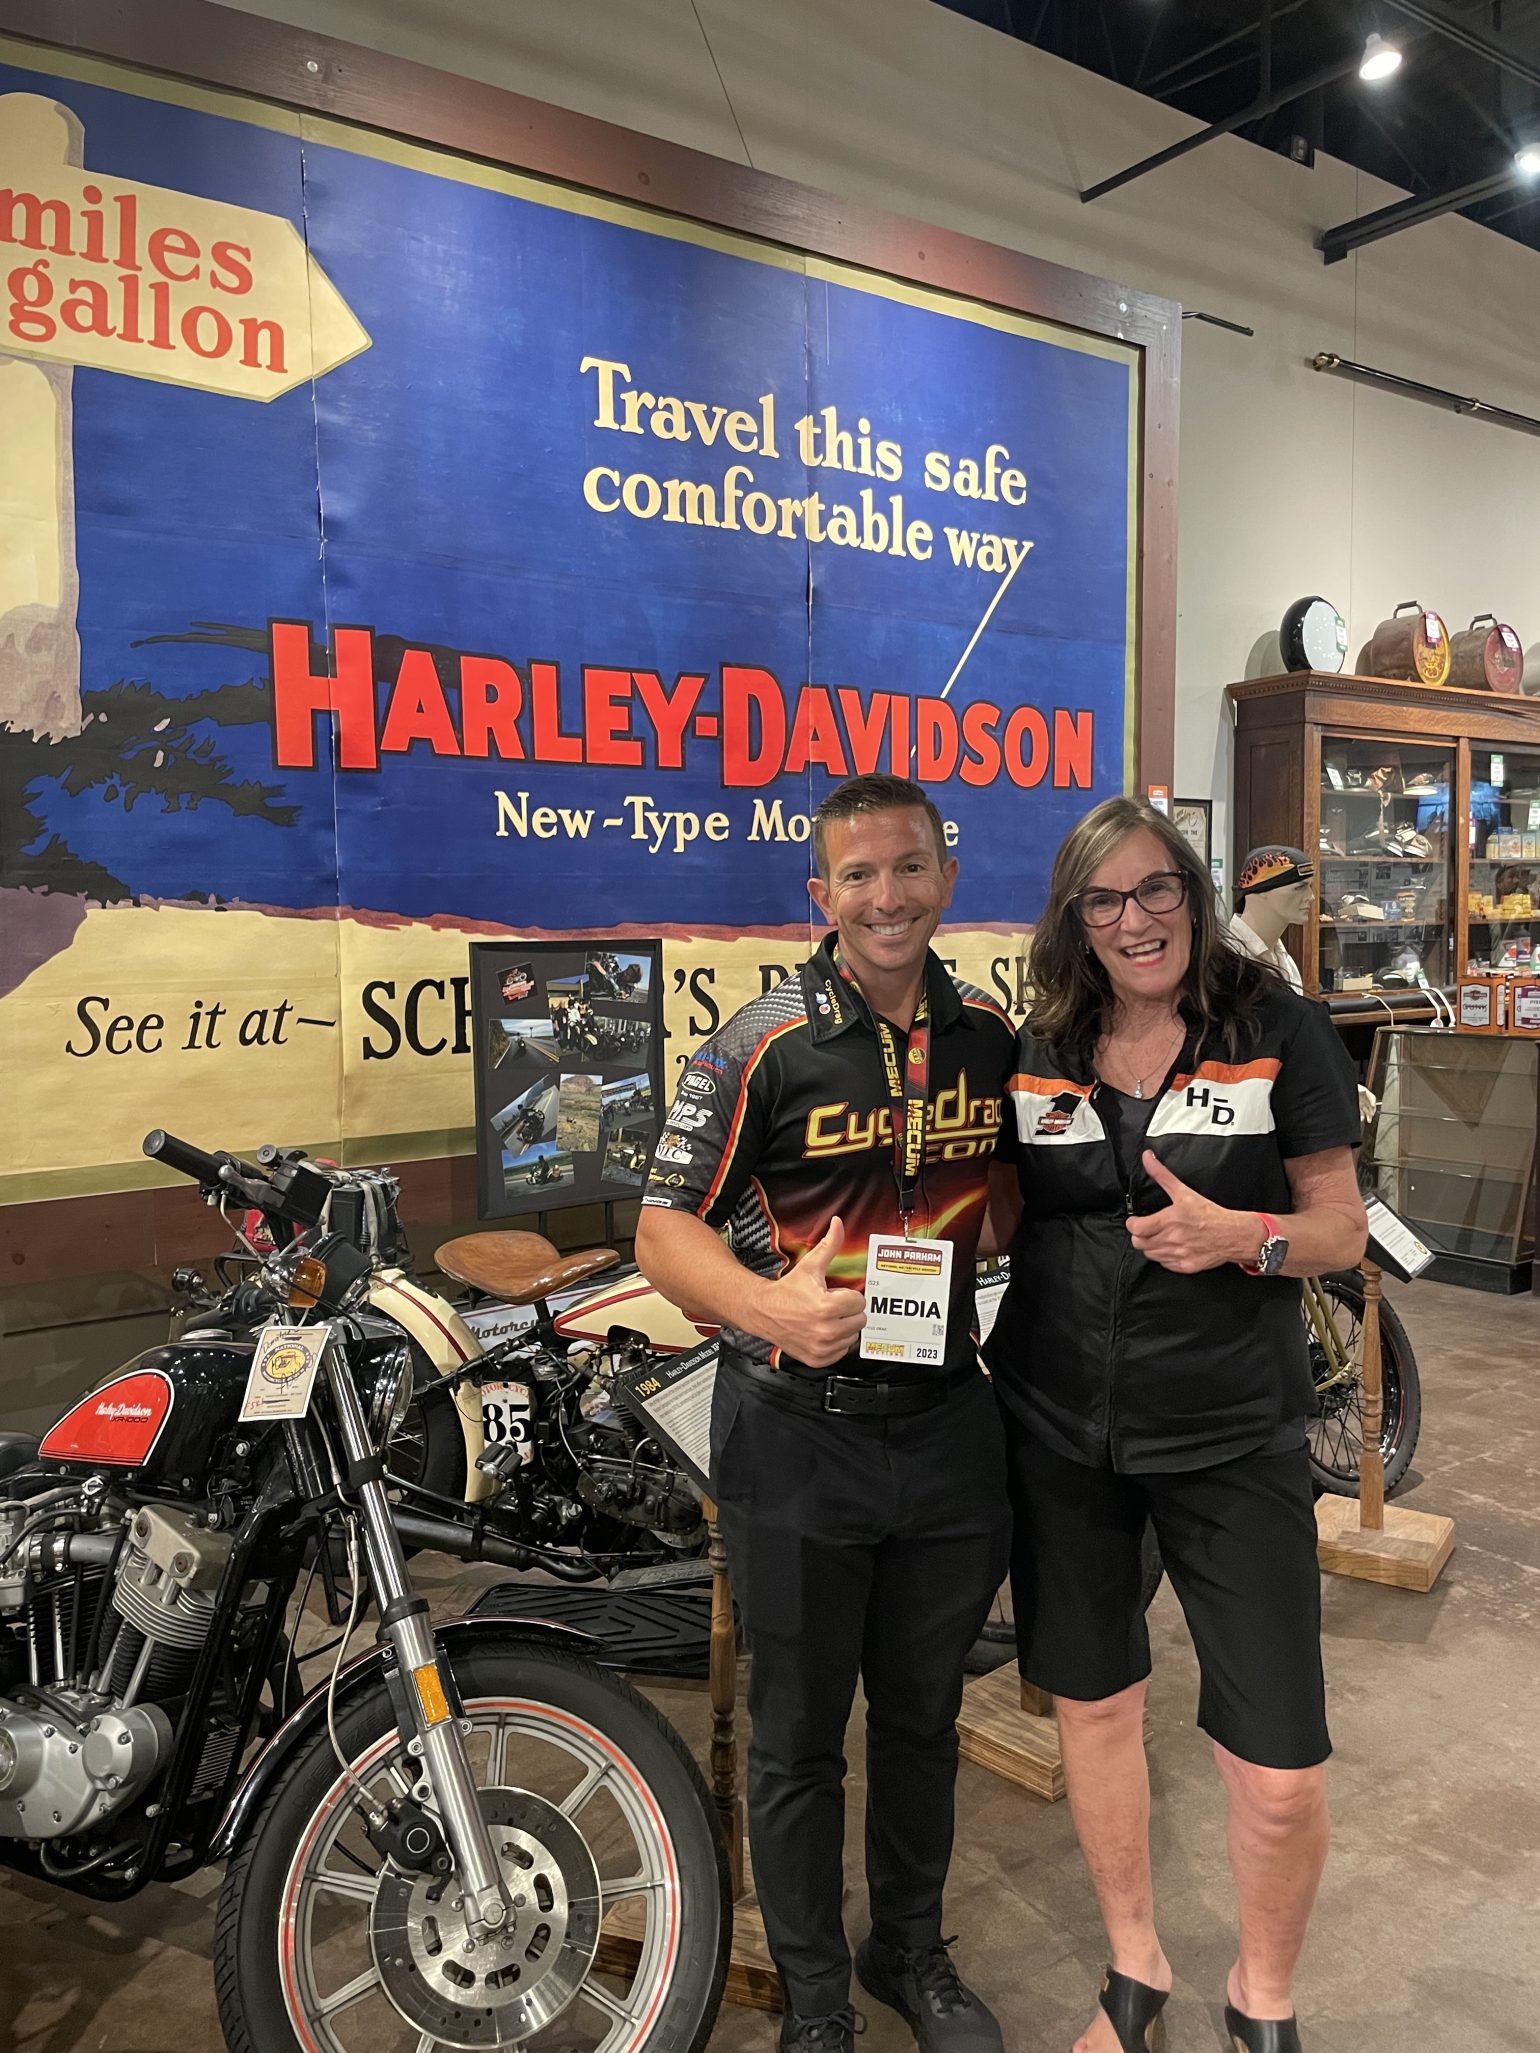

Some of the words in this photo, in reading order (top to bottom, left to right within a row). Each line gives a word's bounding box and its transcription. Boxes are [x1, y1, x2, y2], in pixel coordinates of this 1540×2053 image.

[0, 185, 254, 296] miles
[7, 258, 289, 375] gallon
[579, 356, 780, 459] Travel
[794, 405, 903, 483] this
[923, 444, 1028, 506] safe
[582, 465, 934, 561] comfortable
[270, 621, 1095, 788] HARLEY-DAVIDSON
[65, 996, 165, 1058] See
[181, 999, 227, 1051] it
[824, 979, 843, 1025] CycleDrag
[879, 1022, 903, 1097] MECUM
[905, 1099, 925, 1177] MECUM
[877, 1249, 902, 1259] JOHN
[903, 1251, 942, 1262] PARHAM
[870, 1296, 942, 1319] MEDIA
[634, 1376, 662, 1397] 1984
[916, 1347, 938, 1360] 2023
[482, 1403, 533, 1444] 85
